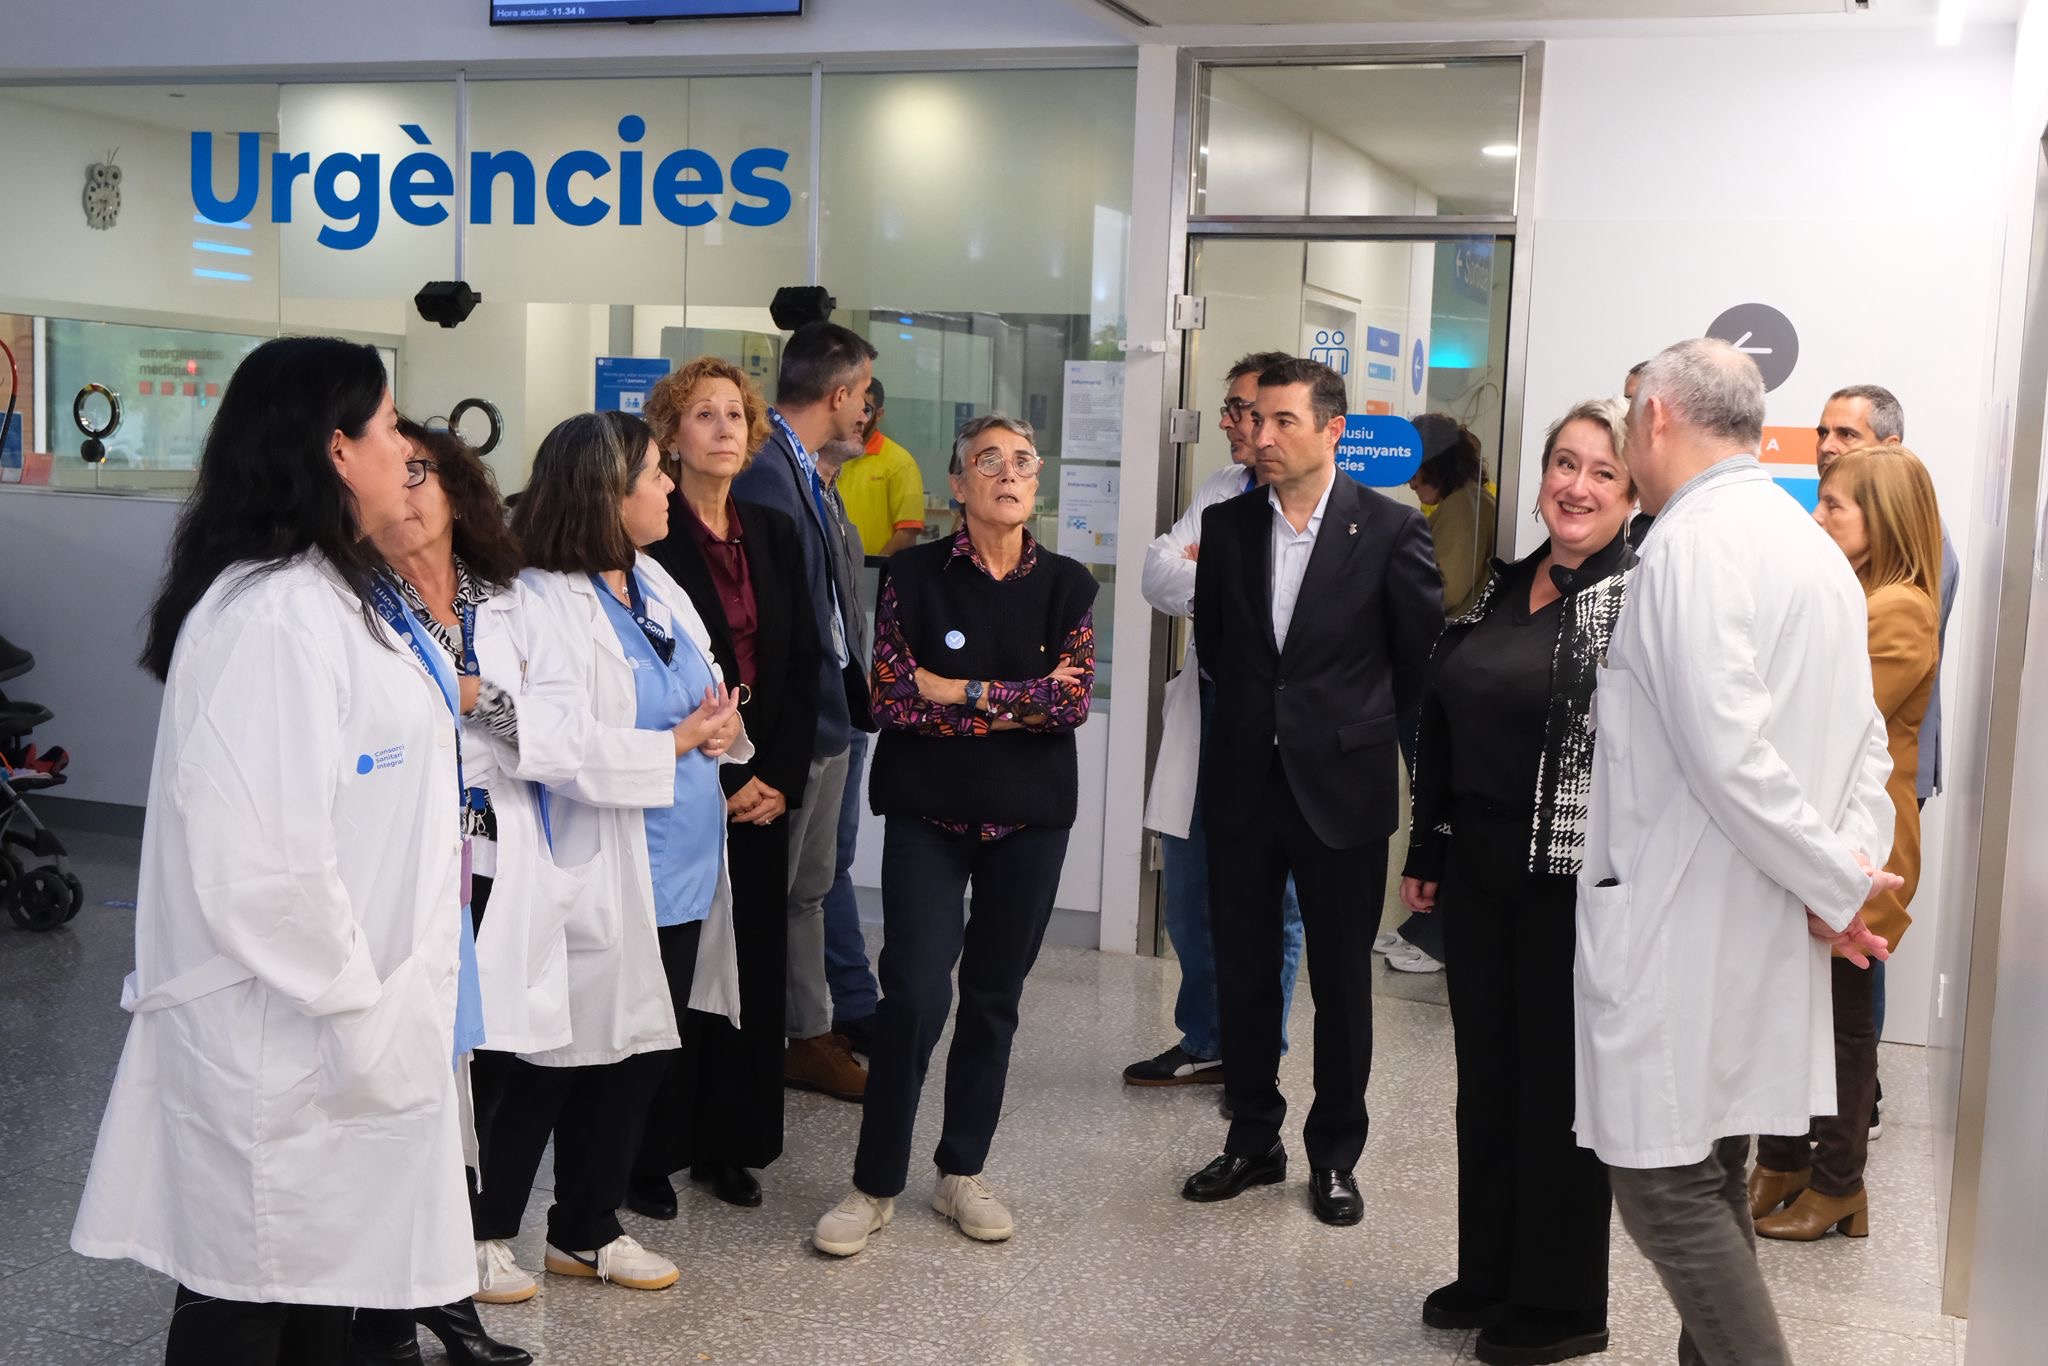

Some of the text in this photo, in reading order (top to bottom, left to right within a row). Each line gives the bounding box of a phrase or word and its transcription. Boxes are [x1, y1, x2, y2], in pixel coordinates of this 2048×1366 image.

[496, 6, 585, 17] Hora actual: 11.34 h
[190, 114, 792, 250] Urgències
[1342, 427, 1374, 439] lusiu
[1765, 438, 1779, 451] A
[1336, 445, 1412, 458] mpanyants
[1337, 459, 1365, 471] cies
[377, 603, 397, 623] CSI
[466, 613, 474, 633] Som
[644, 621, 665, 638] Som
[375, 744, 405, 757] Consorci
[375, 751, 403, 763] Sanitari
[377, 758, 404, 769] Integral
